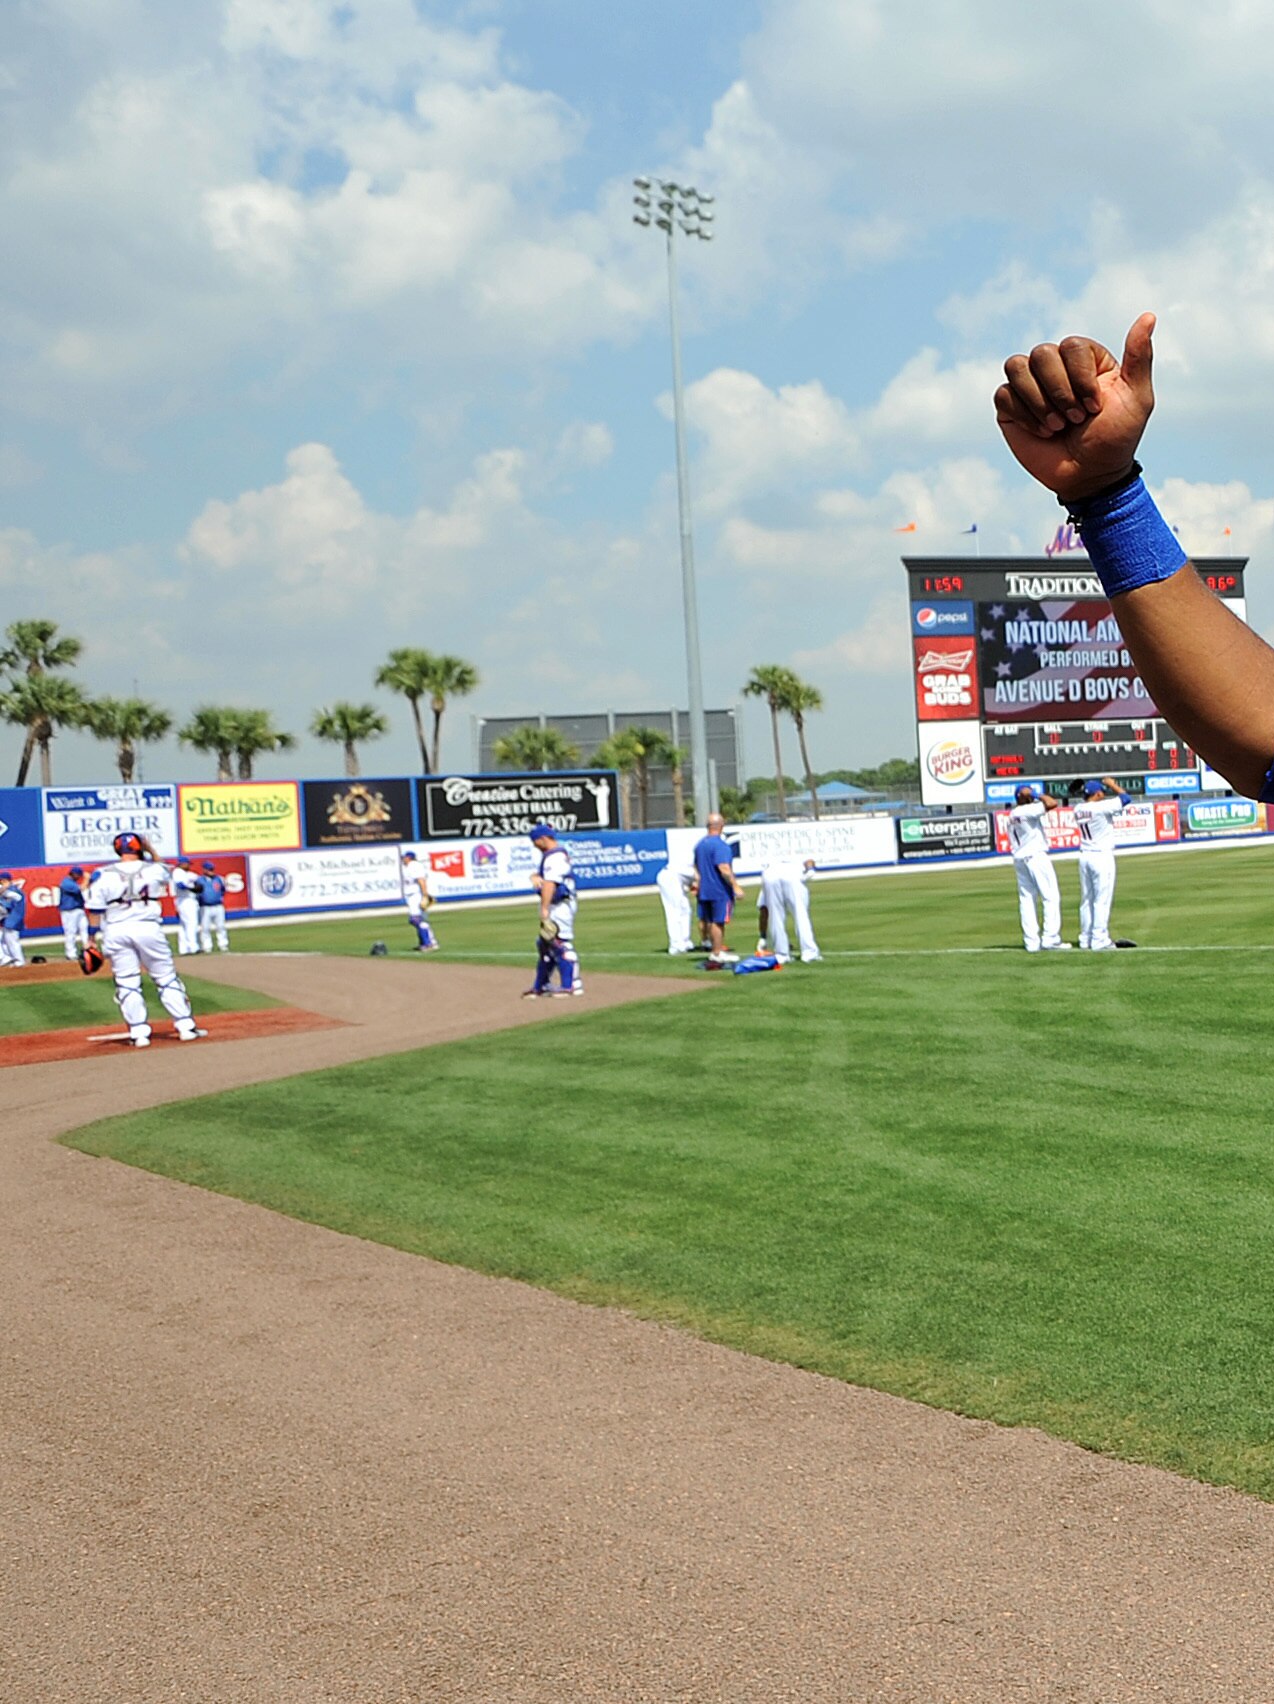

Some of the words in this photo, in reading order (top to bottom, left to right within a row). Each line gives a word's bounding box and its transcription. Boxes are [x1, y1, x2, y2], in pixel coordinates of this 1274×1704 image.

[937, 612, 967, 626] pepsi
[1005, 620, 1092, 644] NATIONAL
[1040, 650, 1118, 668] PERFORMED
[1121, 649, 1135, 667] B
[924, 691, 972, 706] BUDS
[995, 679, 1065, 703] AVENUE
[1068, 679, 1081, 701] D
[1085, 677, 1129, 701] BOYS
[931, 746, 971, 765] BURGER
[934, 754, 974, 778] KING
[1146, 774, 1198, 789] GEICO
[442, 777, 518, 806] Creative
[520, 783, 582, 802] Catering
[186, 795, 292, 818] Nathan's
[472, 802, 529, 816] BANQUET
[530, 801, 563, 814] HALL
[1193, 805, 1228, 821] WASTE
[1230, 804, 1252, 818] PRO
[63, 813, 161, 833] LEGLER
[907, 818, 987, 836] enterprise
[434, 854, 462, 870] KFC
[437, 883, 482, 894] Treasure
[485, 881, 515, 891] Coast
